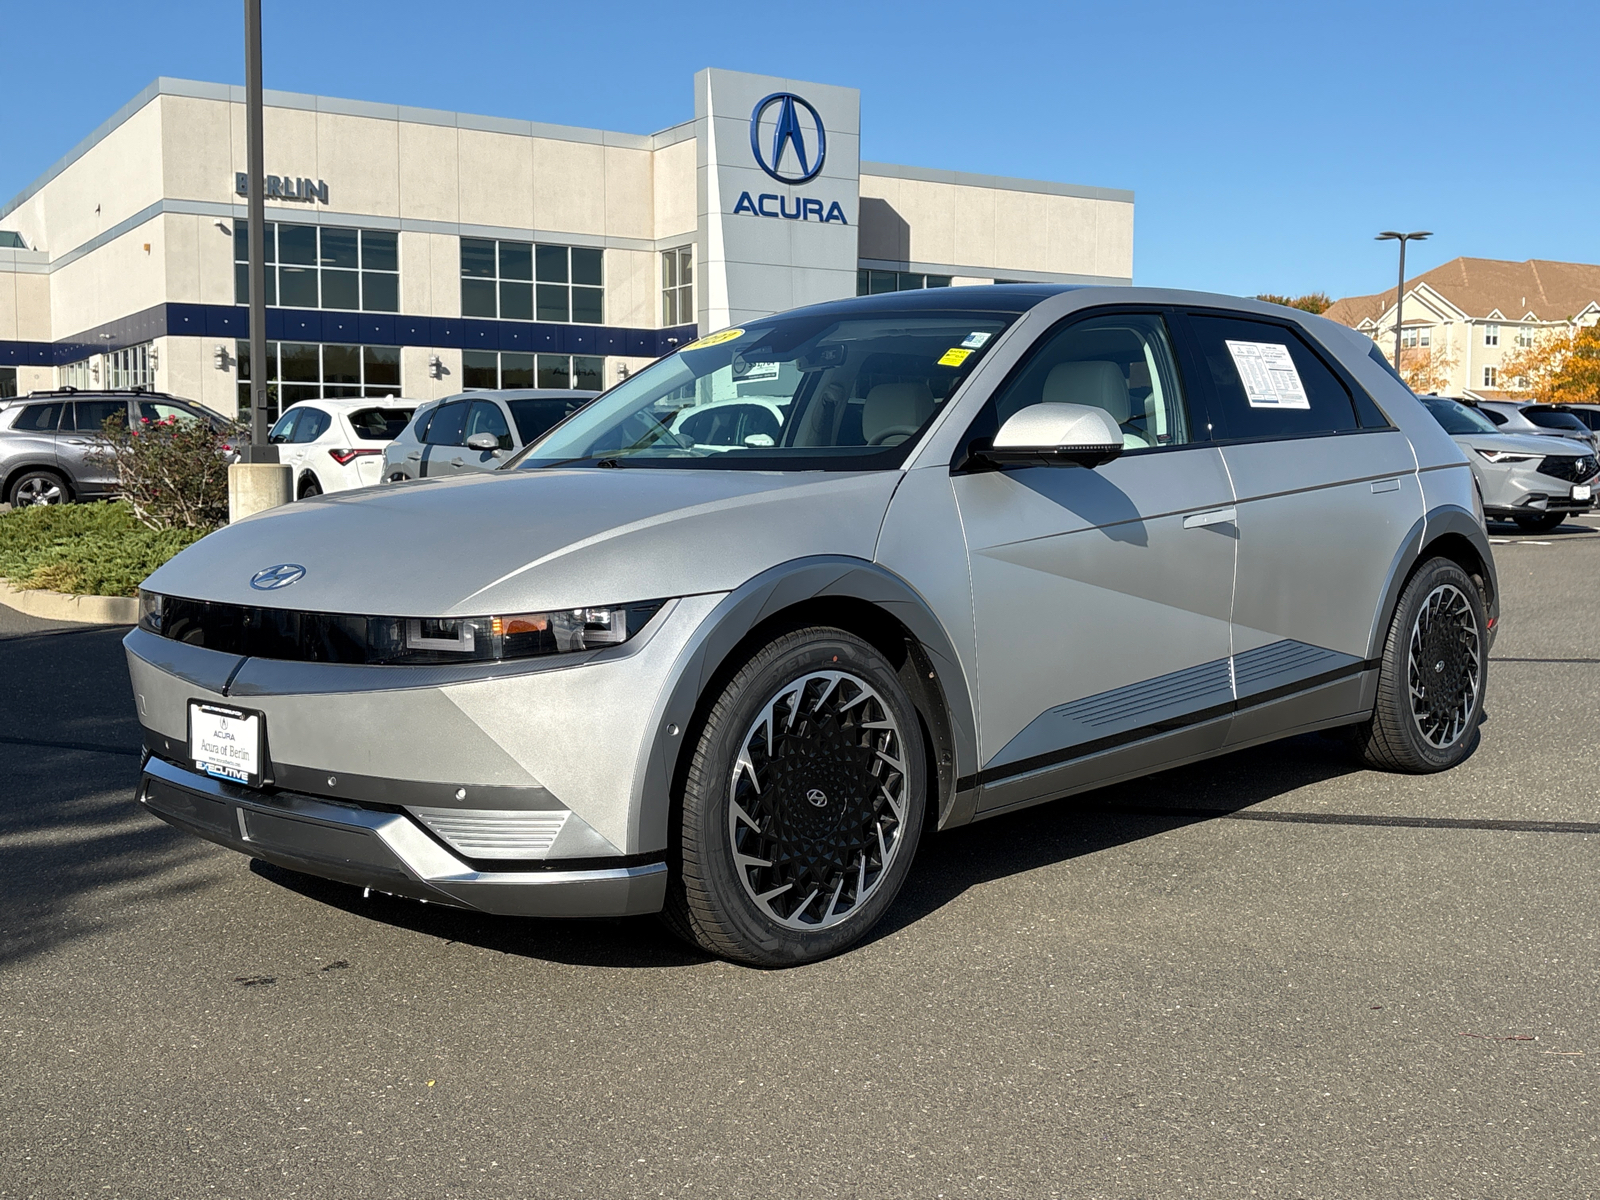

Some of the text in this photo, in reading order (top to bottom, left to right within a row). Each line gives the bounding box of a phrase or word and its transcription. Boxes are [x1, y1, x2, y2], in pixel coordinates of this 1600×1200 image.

[235, 172, 327, 202] BRLIN
[733, 190, 848, 225] ACURA
[213, 730, 235, 741] ACURA
[201, 738, 250, 761] Acura of Berlin
[196, 761, 248, 780] EXECUTIVE
